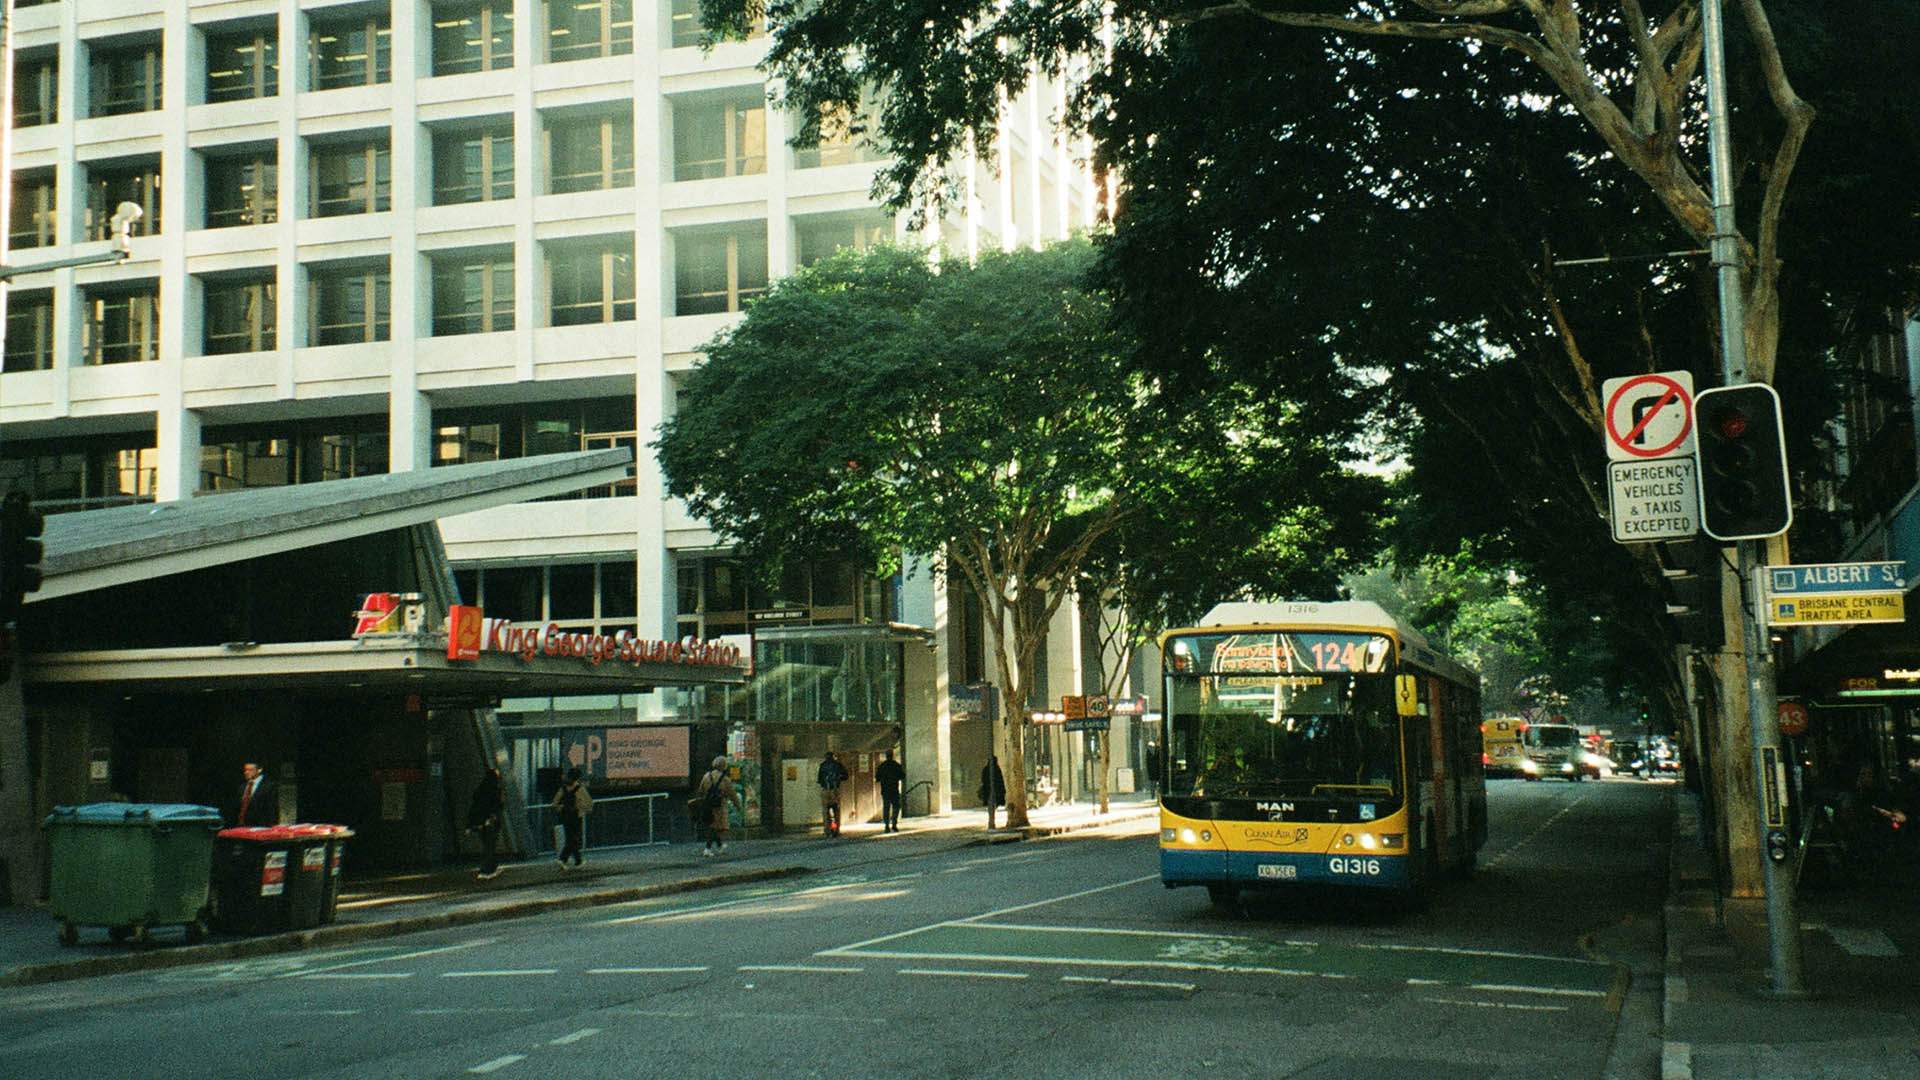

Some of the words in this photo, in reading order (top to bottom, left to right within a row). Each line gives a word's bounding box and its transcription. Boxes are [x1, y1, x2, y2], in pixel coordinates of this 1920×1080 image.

[1614, 464, 1691, 482] EMERGENCY
[1623, 482, 1684, 499] VEHICLES
[1630, 505, 1639, 516] &
[1645, 500, 1682, 515] TAXIS
[1624, 517, 1691, 534] EXCEPTED
[1803, 565, 1871, 585] ALBERT
[1287, 604, 1320, 614] 1316
[1799, 598, 1848, 610] BRISBANE
[1852, 596, 1899, 608] CENTRAL
[1800, 609, 1841, 621] TRAFFIC
[1846, 609, 1873, 620] AREA
[486, 617, 538, 663] King
[543, 623, 616, 666] George
[618, 630, 681, 668] Square
[683, 634, 741, 666] Station
[1311, 640, 1357, 671] 124
[1090, 701, 1105, 713] 40
[1779, 711, 1802, 726] 43
[587, 735, 602, 775] P
[1256, 801, 1295, 812] MAN
[1329, 857, 1381, 876] G1316
